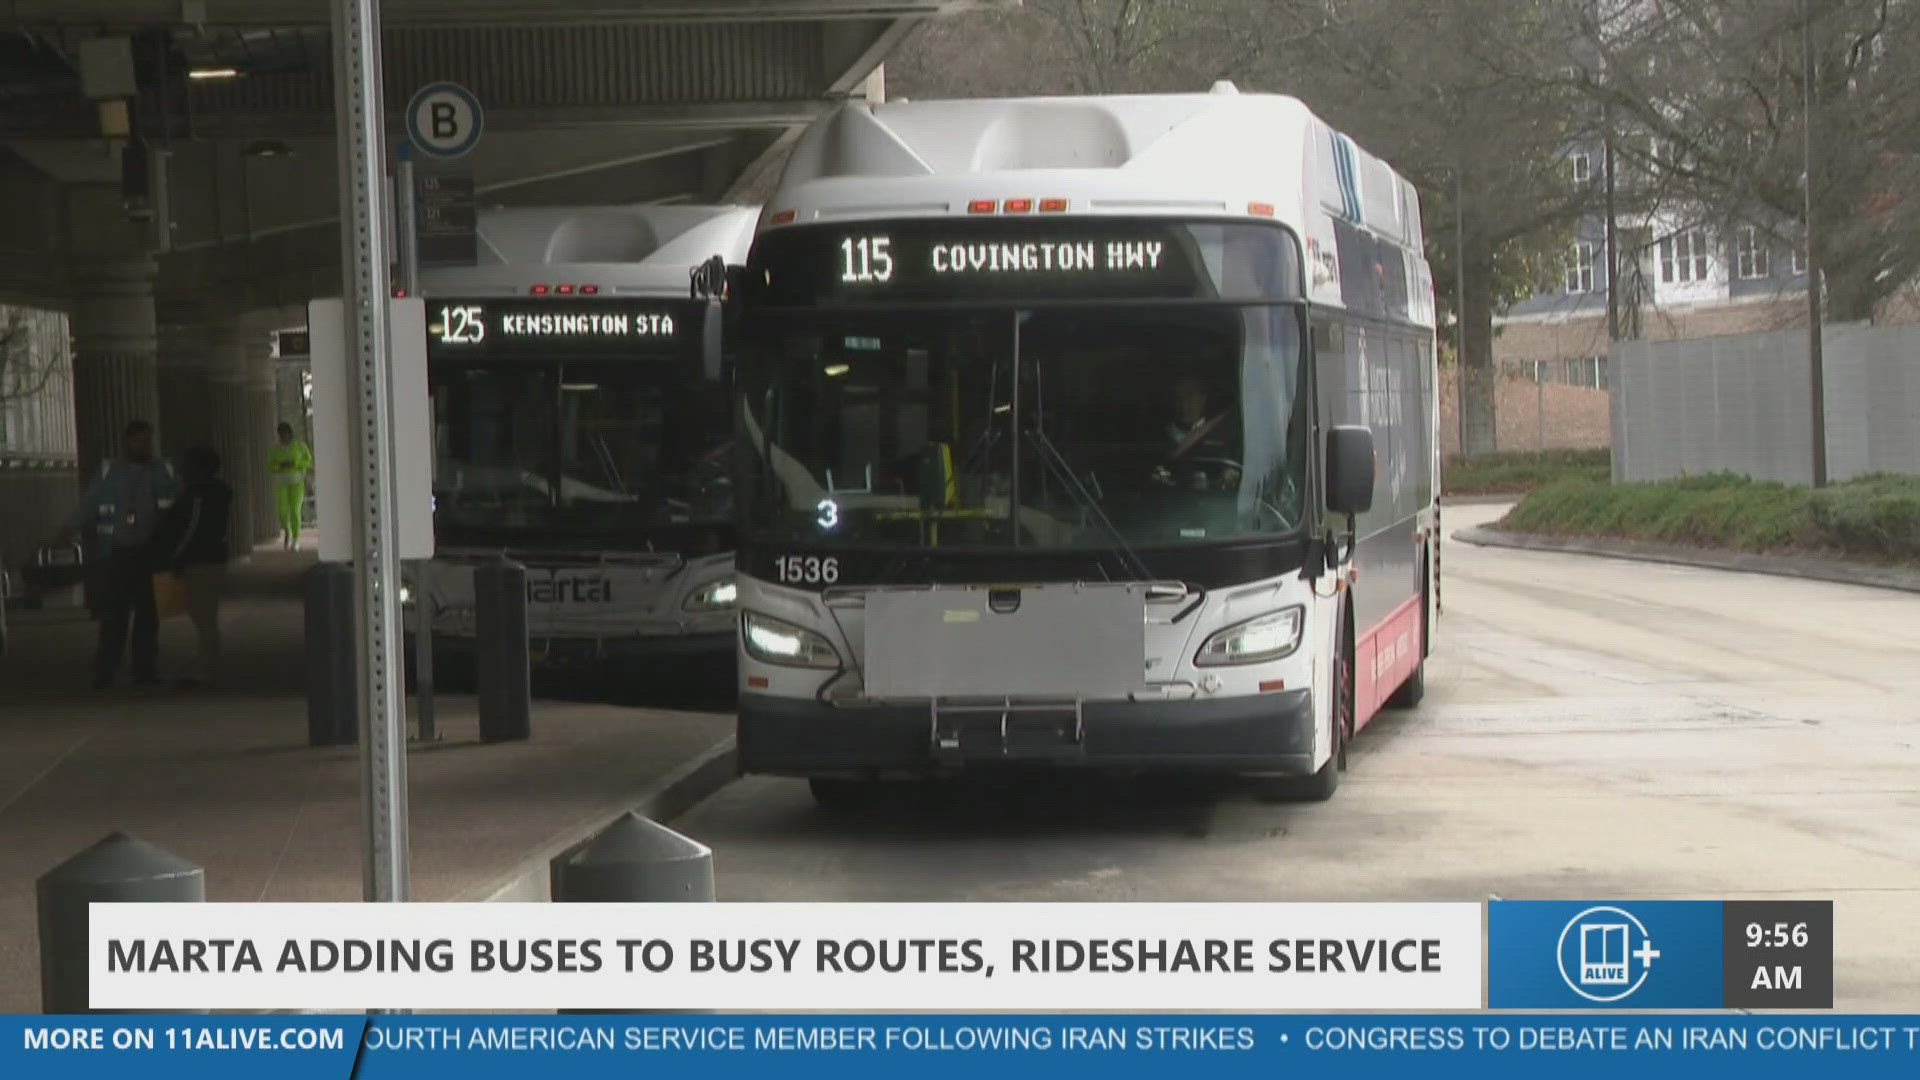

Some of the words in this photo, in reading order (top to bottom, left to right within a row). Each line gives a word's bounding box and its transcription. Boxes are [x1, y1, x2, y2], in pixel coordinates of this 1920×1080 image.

[432, 103, 457, 139] B
[840, 236, 893, 282] 115
[932, 242, 1095, 271] COVINGTON
[1107, 241, 1162, 269] HWY
[440, 306, 485, 343] 125
[503, 314, 628, 335] KENSINGTON
[636, 314, 673, 335] STA
[817, 499, 838, 528] 3
[774, 557, 839, 583] 1536
[527, 577, 610, 603] arta
